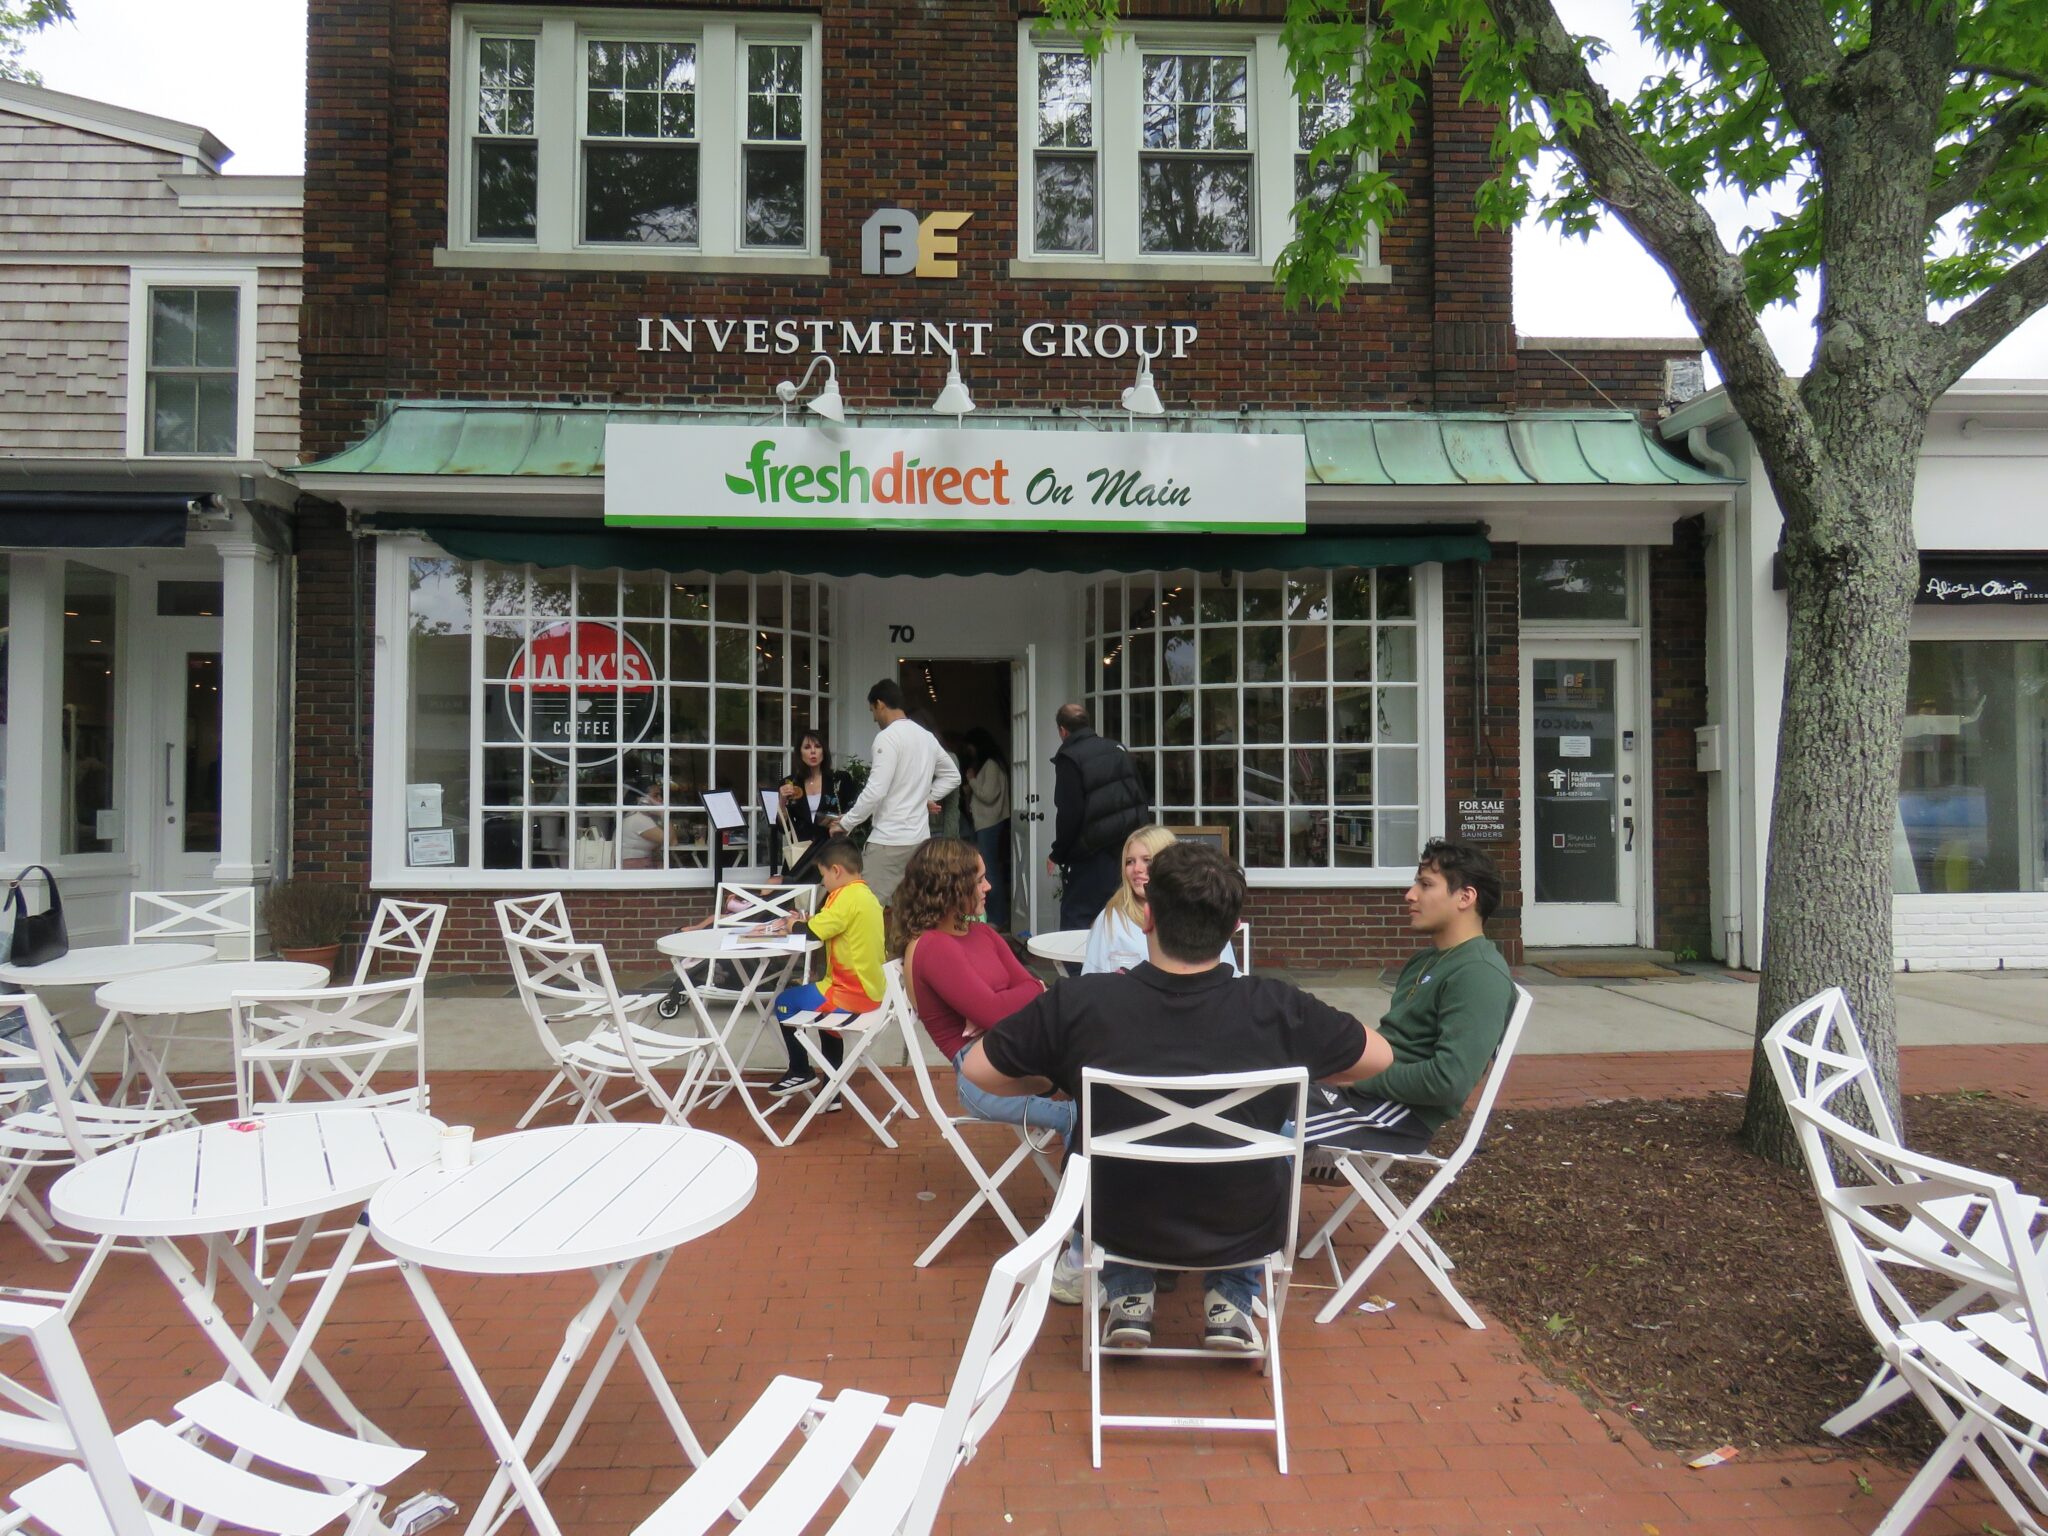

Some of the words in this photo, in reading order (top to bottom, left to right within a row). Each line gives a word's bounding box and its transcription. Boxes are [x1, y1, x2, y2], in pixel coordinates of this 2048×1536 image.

[861, 208, 975, 277] BE
[636, 318, 993, 356] INVESTMENT
[1022, 322, 1199, 359] GROUP
[745, 440, 1010, 505] freshdirect
[1026, 467, 1074, 506] On
[1086, 467, 1192, 508] Main
[889, 624, 915, 643] 70
[517, 653, 641, 688] JACK'S
[553, 721, 610, 735] COFFEE
[420, 800, 427, 808] A
[1458, 800, 1479, 810] FOR
[1481, 800, 1505, 810] SALE
